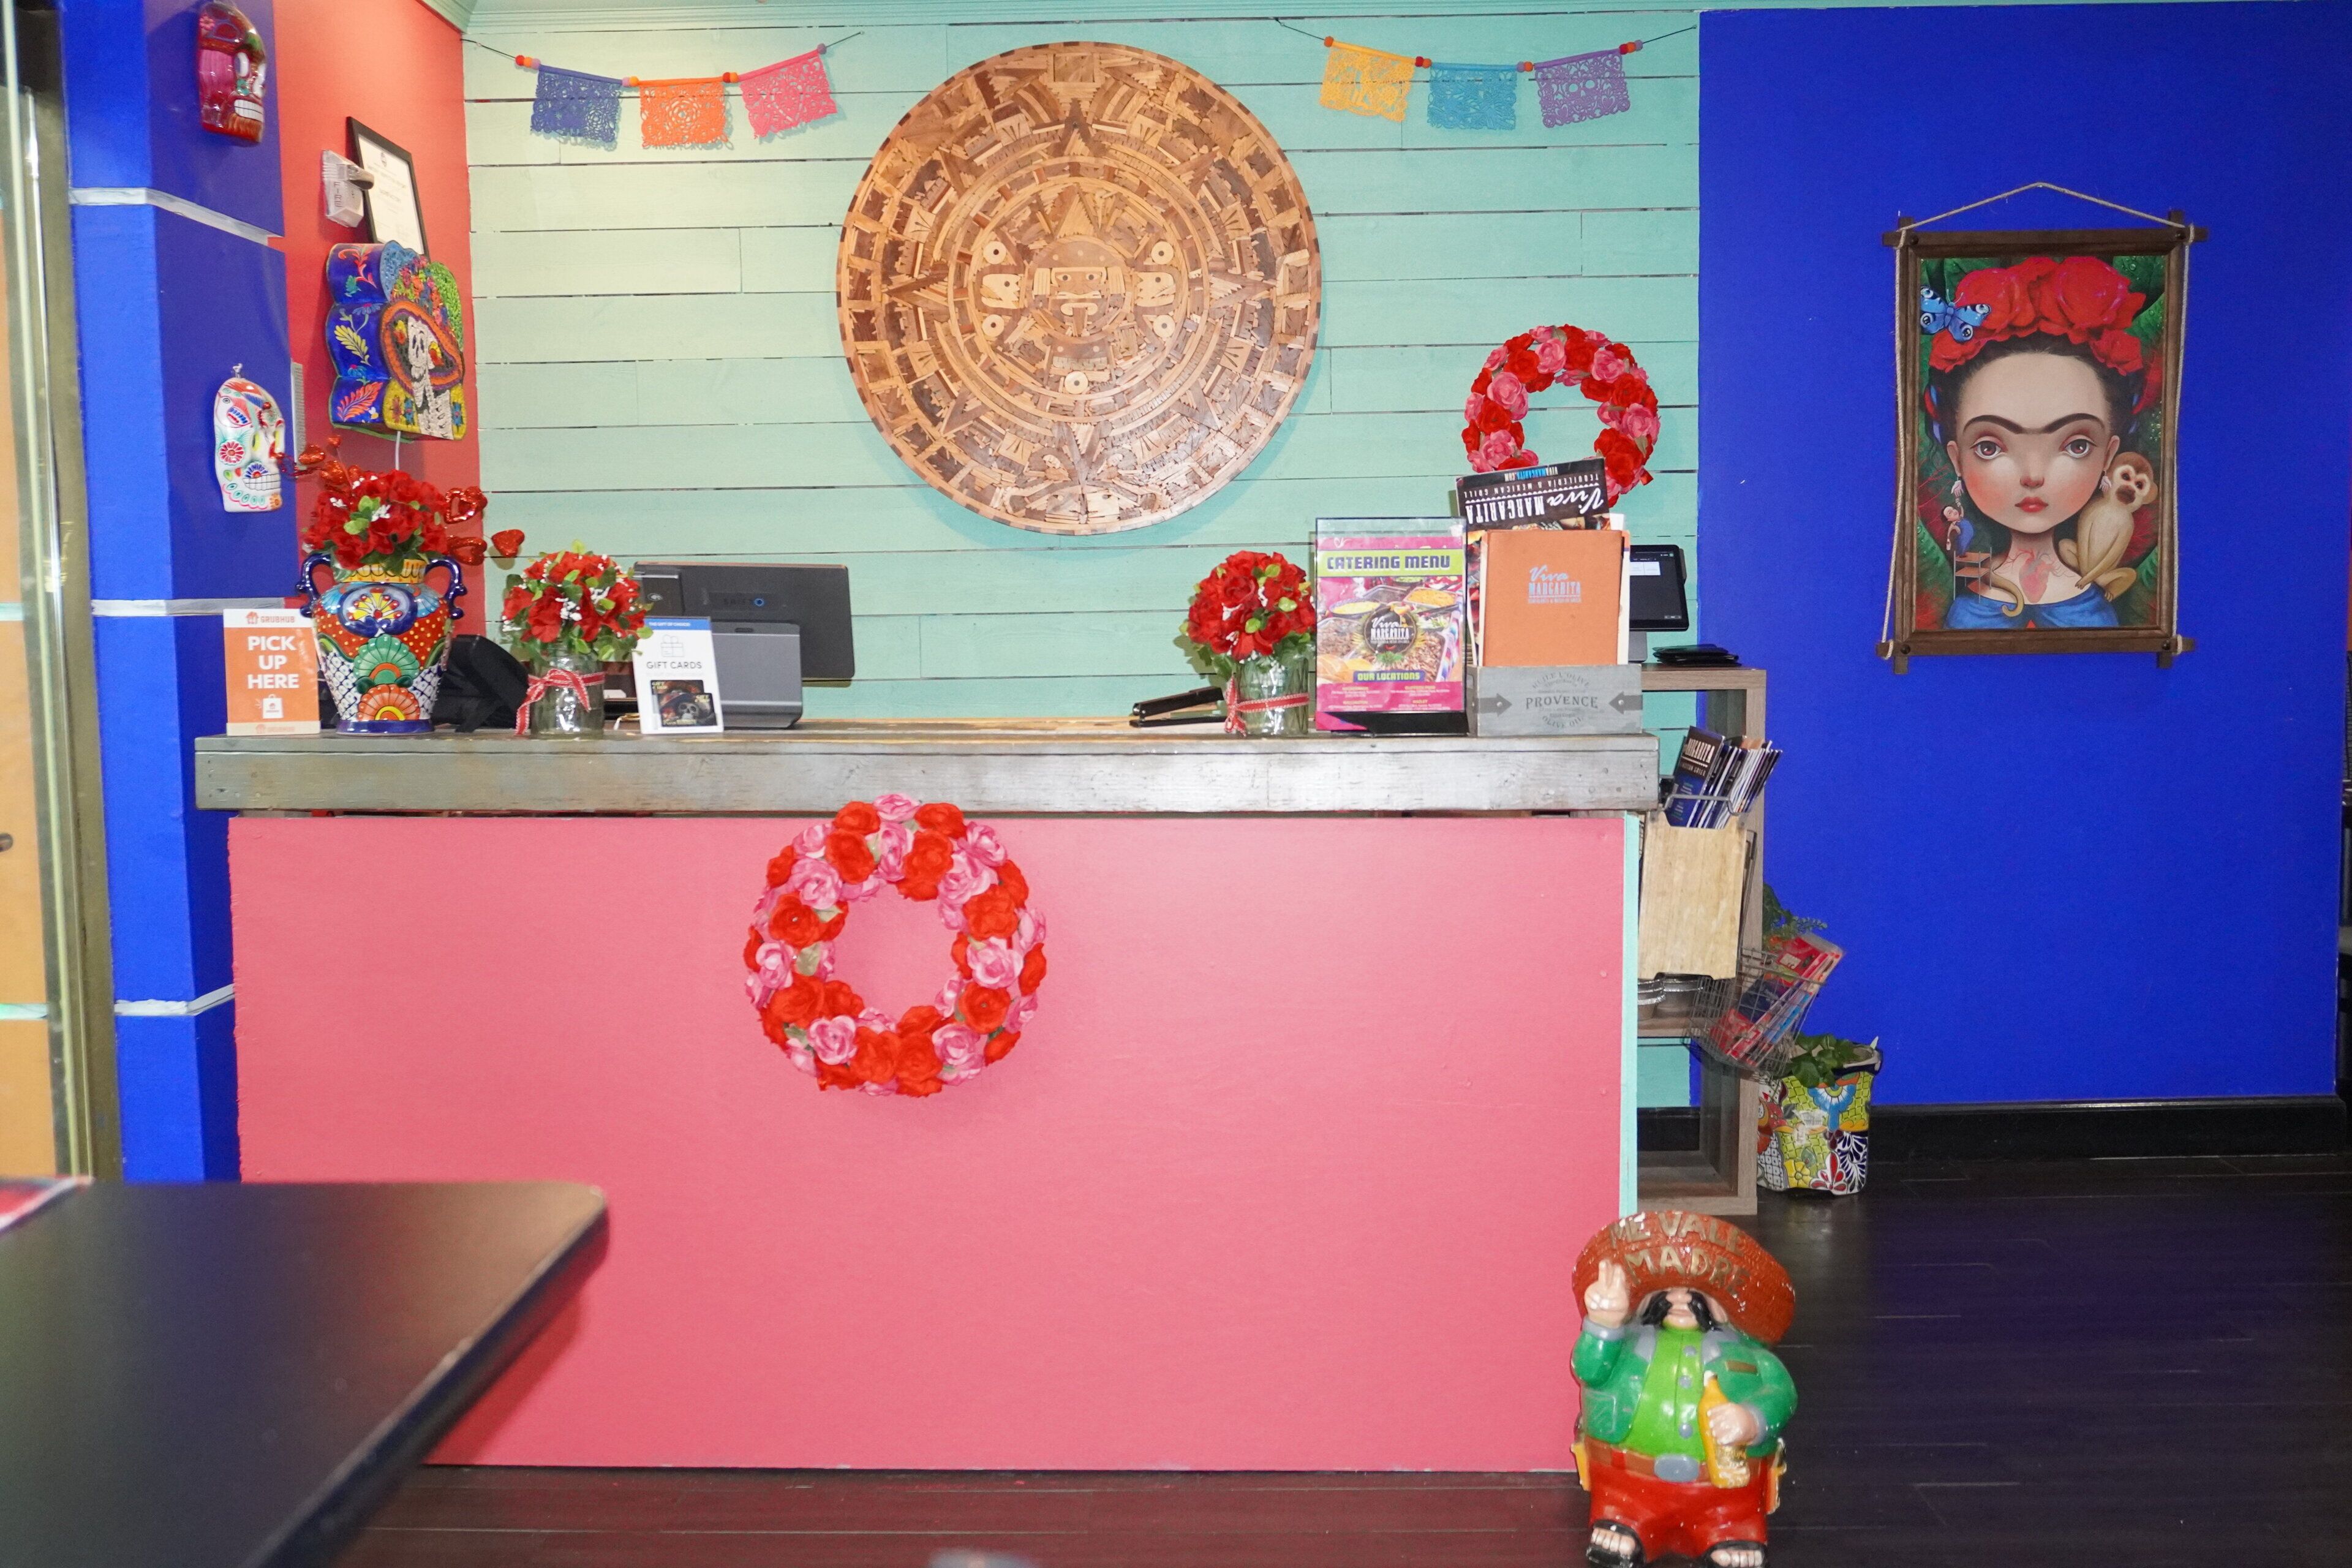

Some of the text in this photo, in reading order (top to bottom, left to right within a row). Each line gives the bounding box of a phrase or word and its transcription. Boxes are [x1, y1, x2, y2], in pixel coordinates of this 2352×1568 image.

[333, 181, 343, 208] FIRE
[1504, 466, 1558, 482] VIVAMARGARITA.COM
[1464, 488, 1488, 499] GRILL
[1494, 483, 1532, 495] MEXICAN
[1465, 487, 1604, 525] Viva MARGARITA
[1327, 555, 1450, 570] CATERING MENU
[1529, 565, 1569, 581] Viva
[247, 636, 297, 651] PICK
[258, 655, 287, 670] UP
[247, 674, 300, 689] HERE
[1357, 671, 1420, 681] OUR LOCATIONS
[1526, 695, 1598, 709] PROVENCE
[1608, 1212, 1745, 1258] ME VALE
[1625, 1245, 1751, 1296] MADRE
